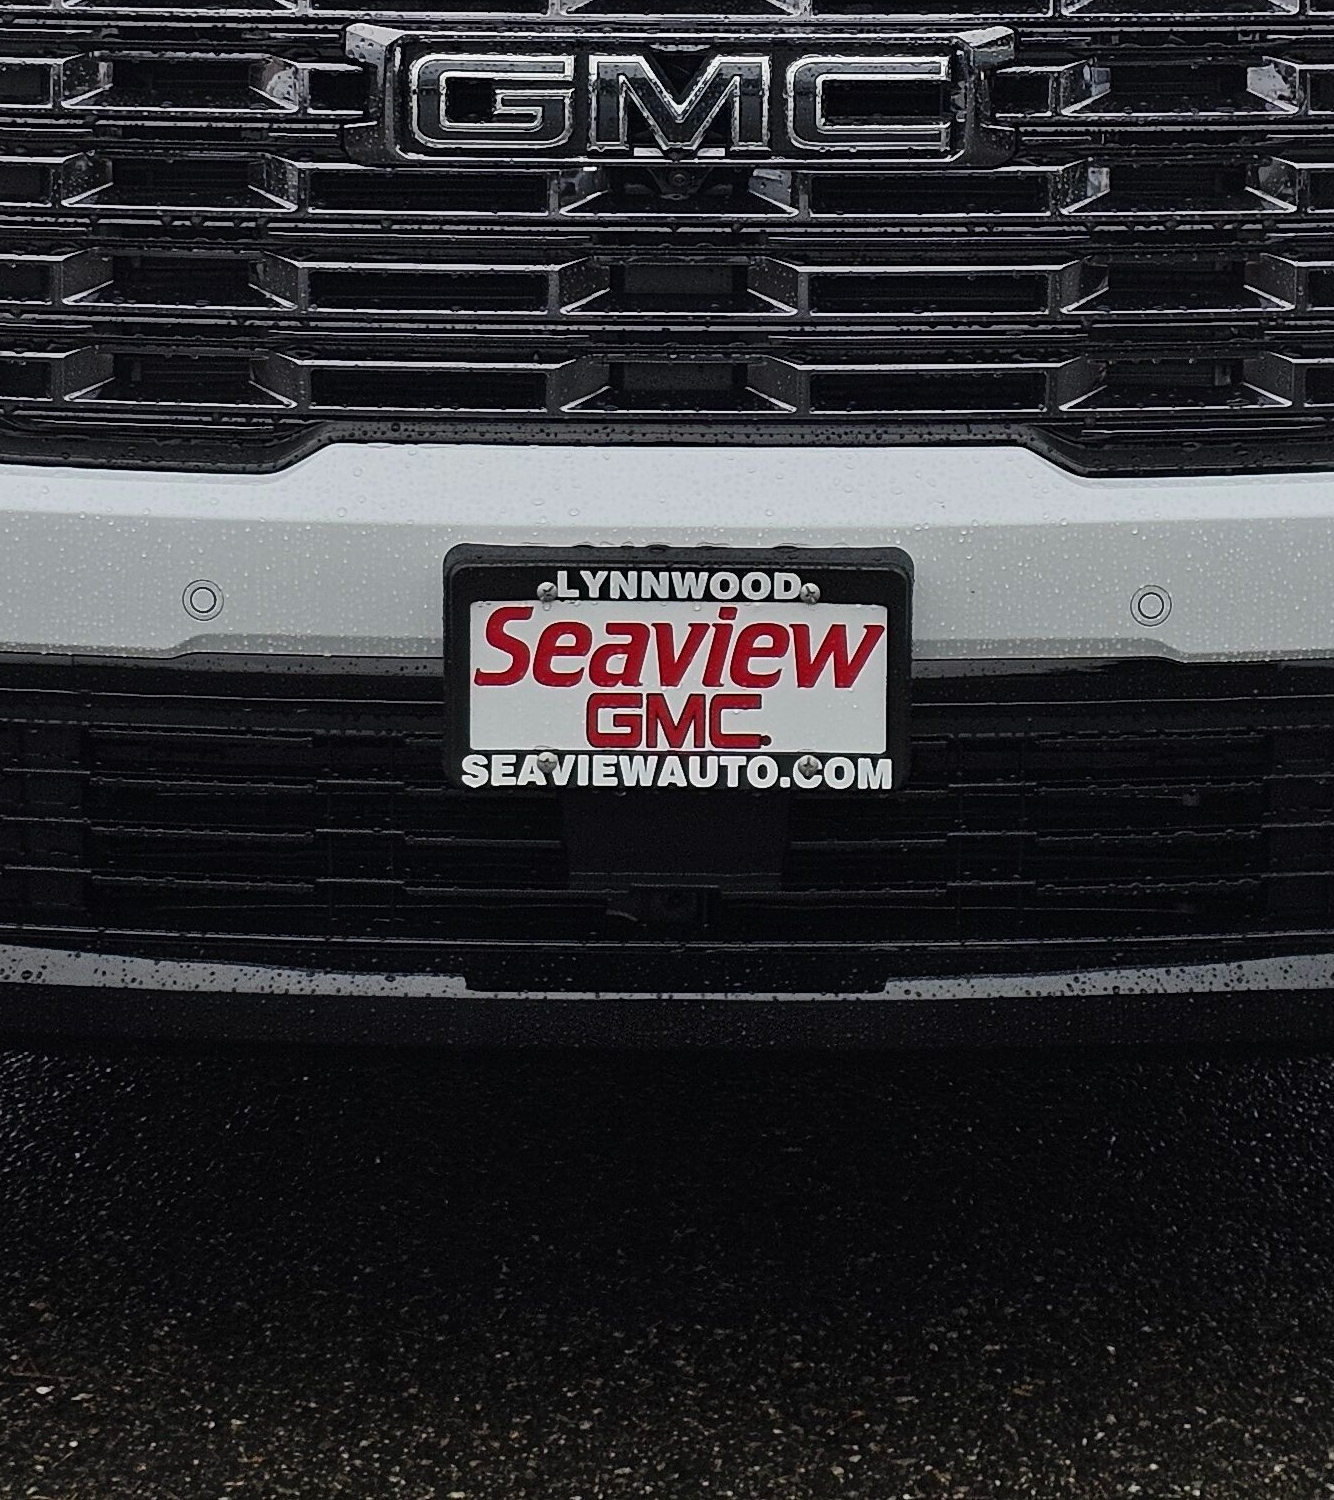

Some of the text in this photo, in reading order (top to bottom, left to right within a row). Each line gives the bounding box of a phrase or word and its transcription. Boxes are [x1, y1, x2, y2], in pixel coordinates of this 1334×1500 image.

[409, 52, 951, 152] GMC
[556, 570, 802, 599] LYNNWOOD
[473, 606, 886, 689] Seaview
[585, 692, 765, 749] GMC
[461, 754, 893, 789] SEAVIEWAUTO.COM
